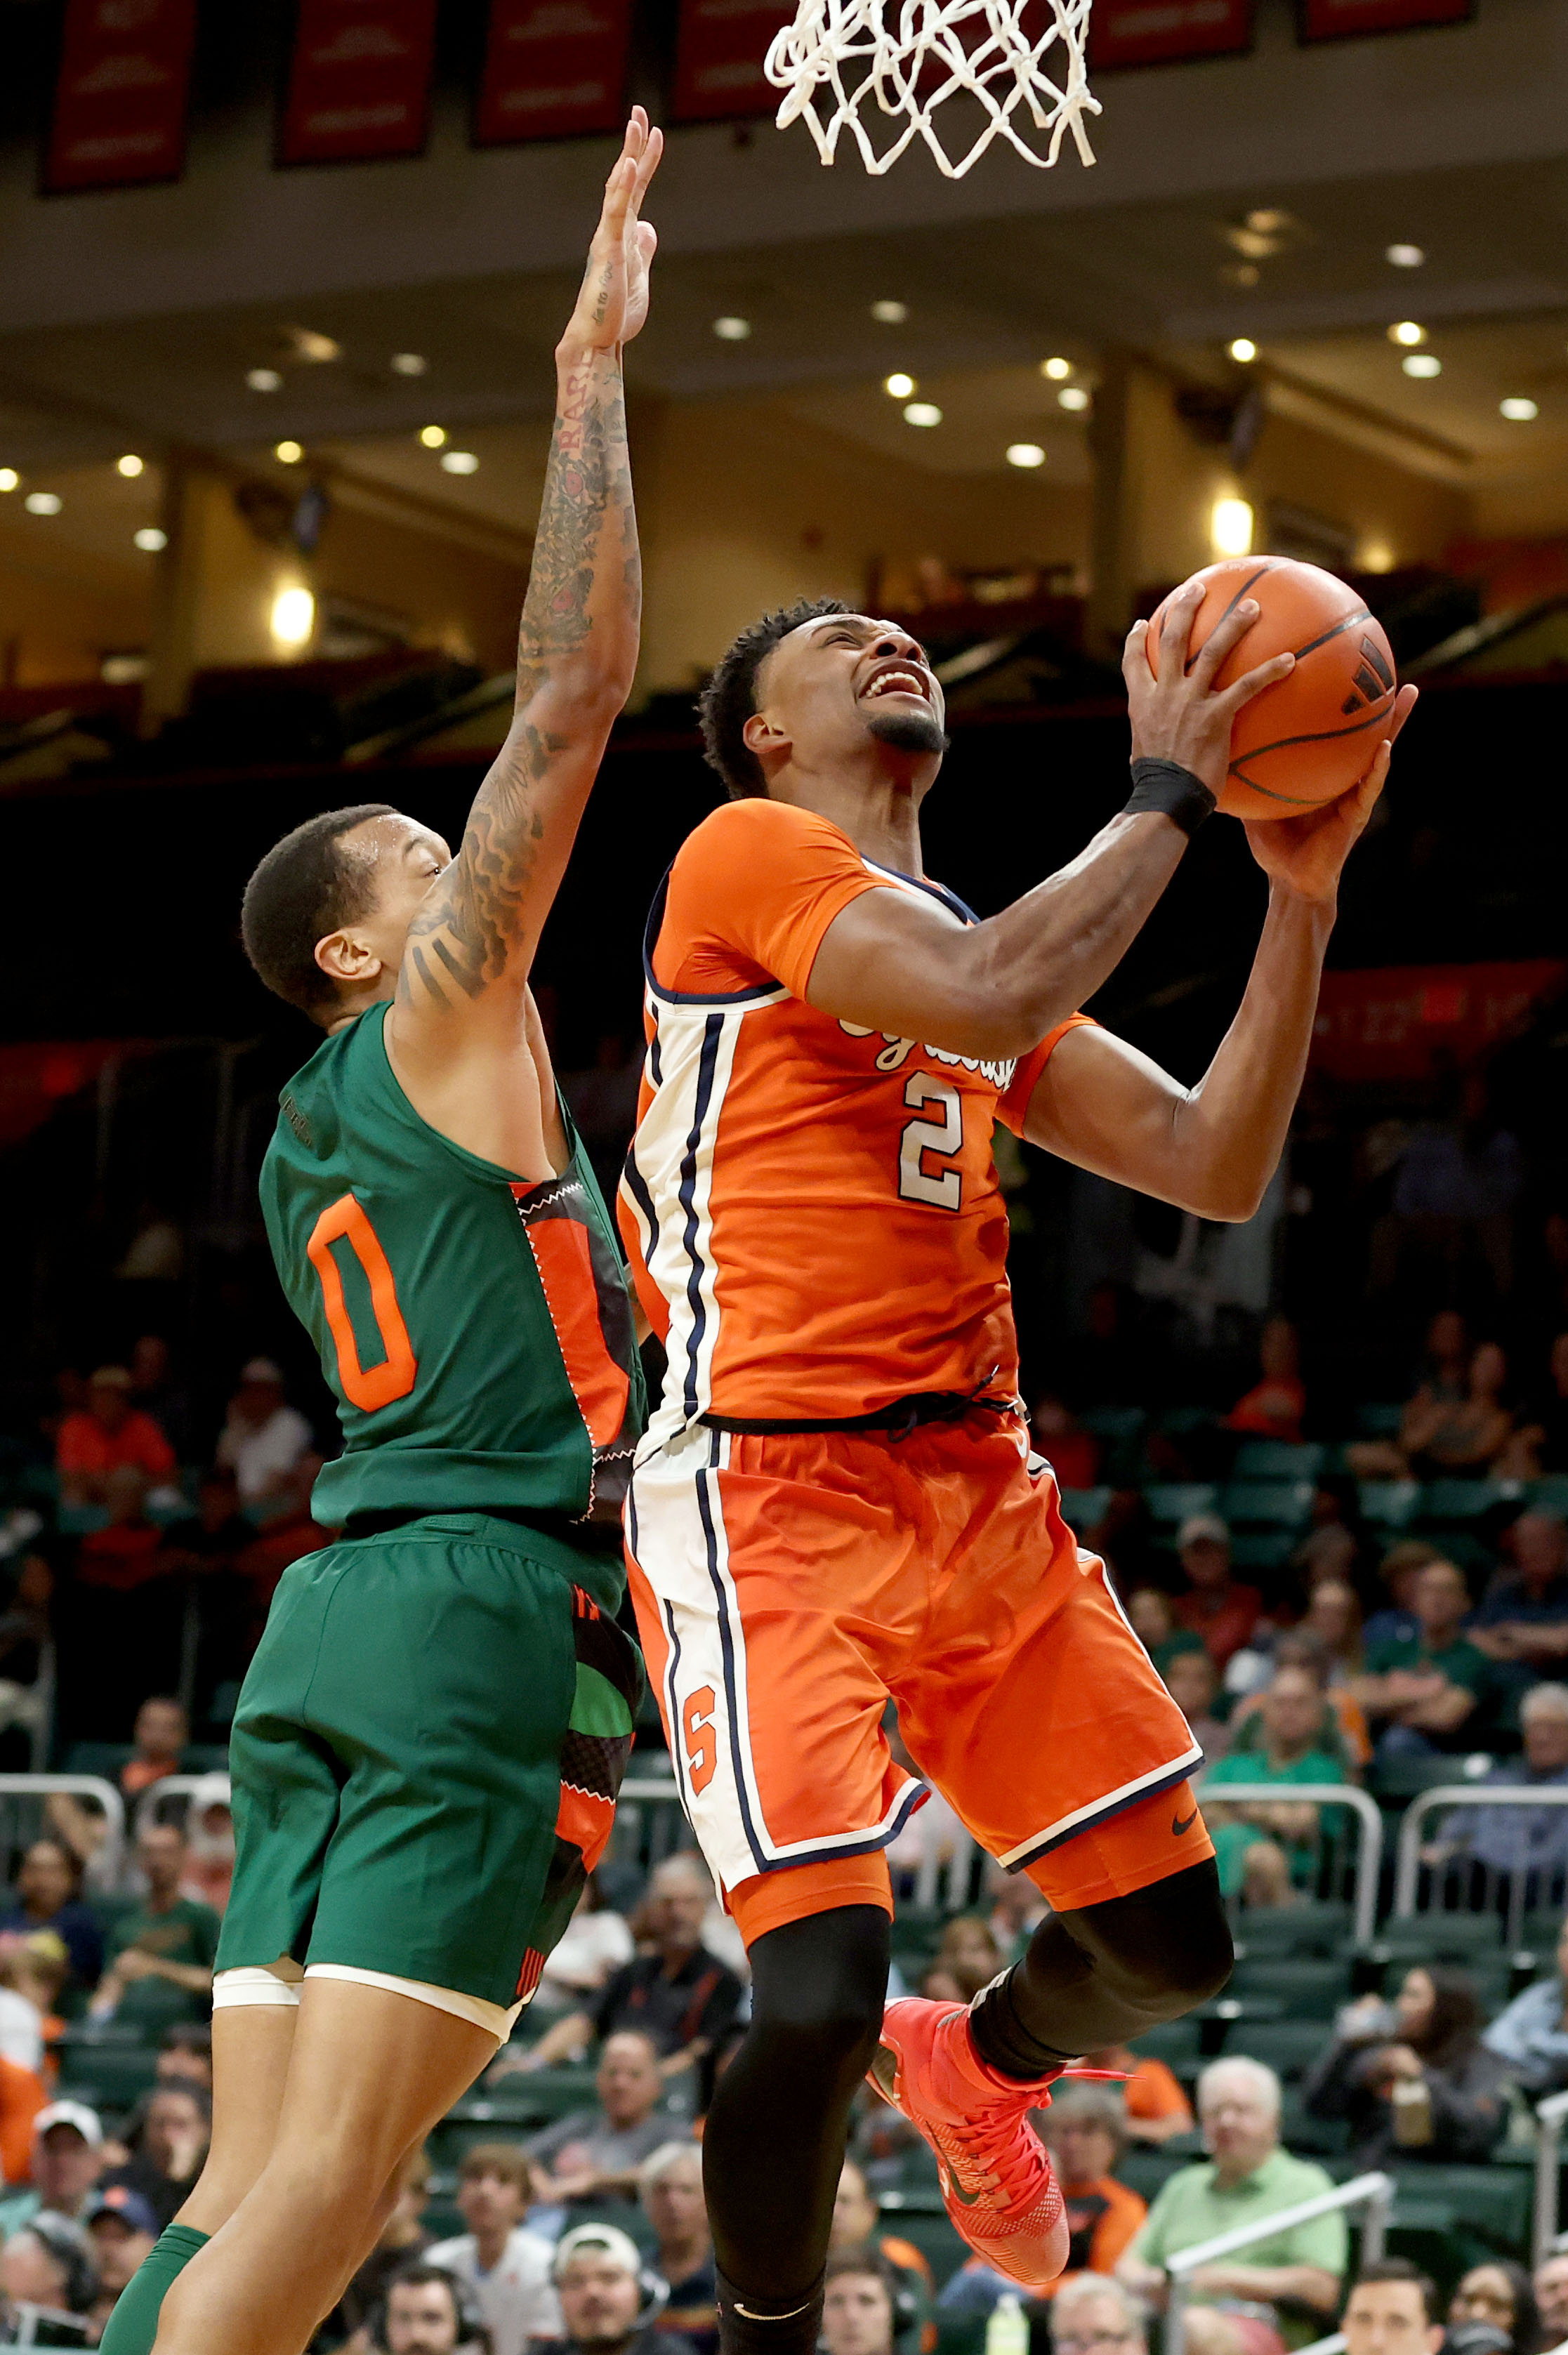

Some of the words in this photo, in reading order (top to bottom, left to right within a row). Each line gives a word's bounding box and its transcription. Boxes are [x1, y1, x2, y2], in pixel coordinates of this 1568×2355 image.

[897, 1071, 963, 1213] 2
[307, 1193, 418, 1413] 0
[683, 1684, 717, 1797] S
